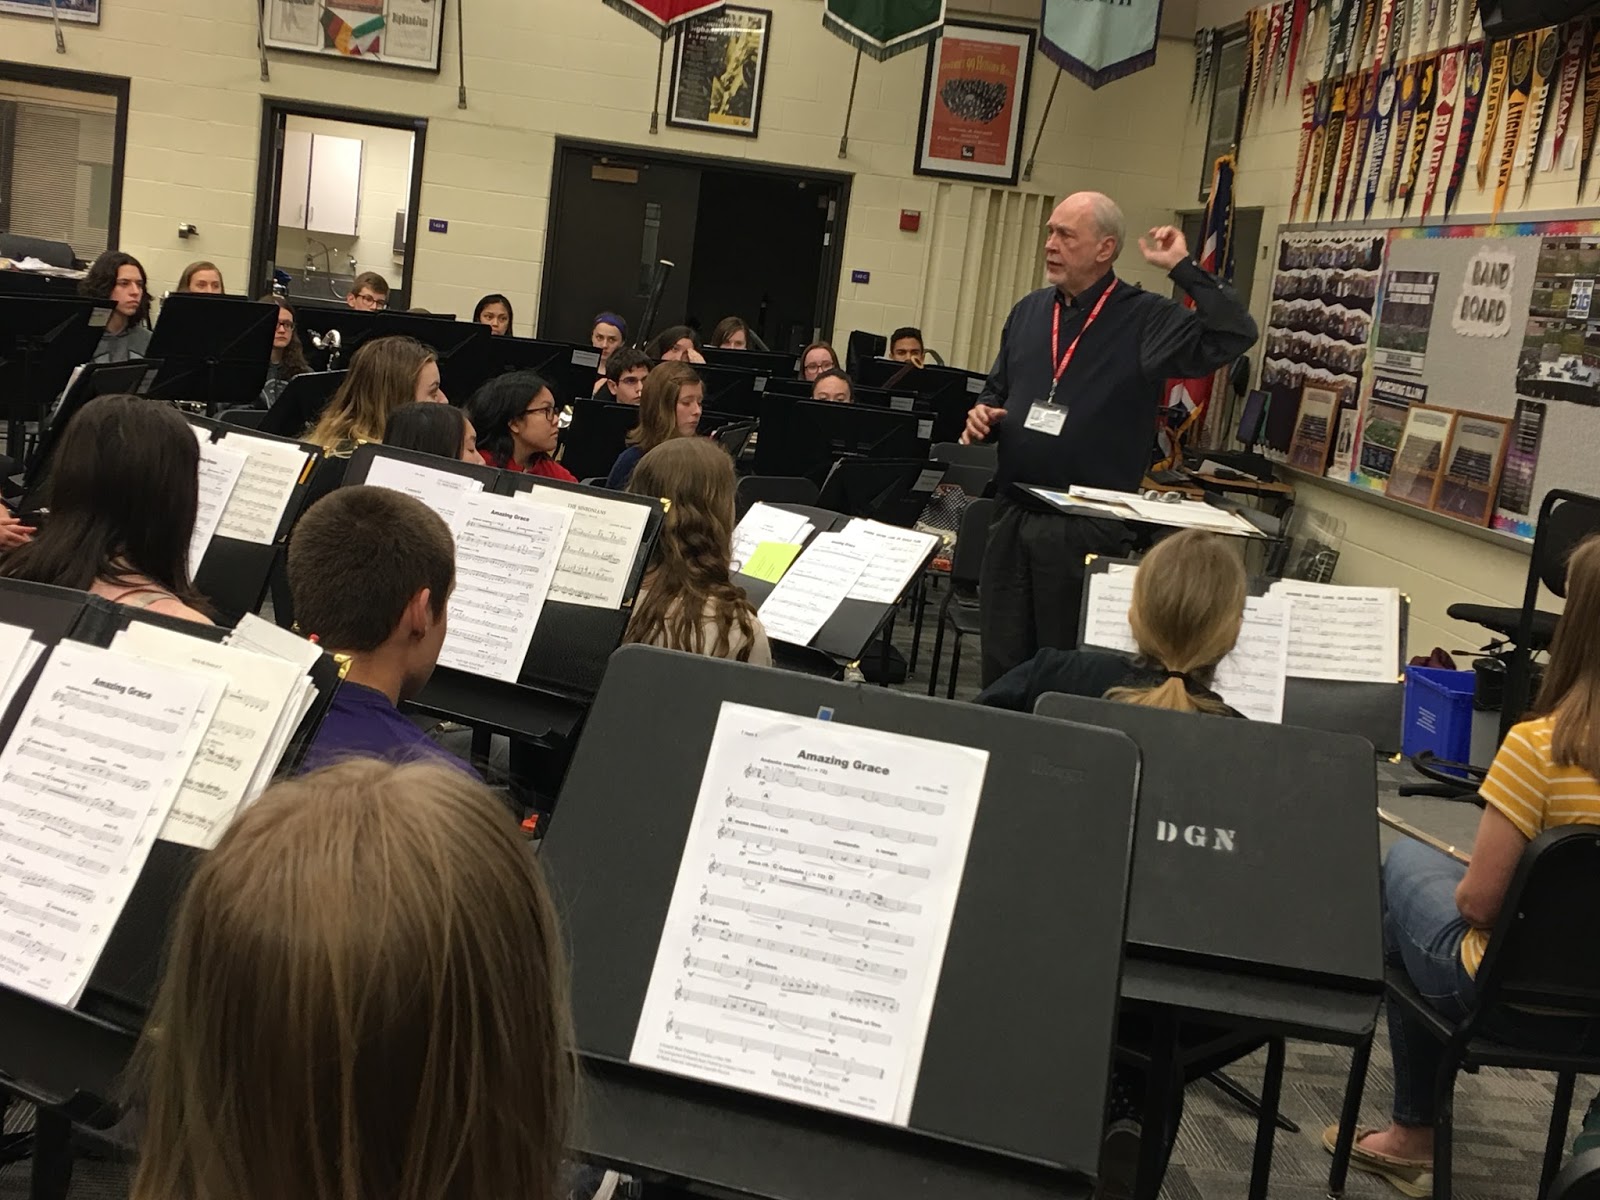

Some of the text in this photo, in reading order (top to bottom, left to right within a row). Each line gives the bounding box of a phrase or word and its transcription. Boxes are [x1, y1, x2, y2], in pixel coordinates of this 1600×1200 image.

[1555, 59, 1580, 138] INDIANA
[1408, 111, 1430, 186] IOWA
[1425, 114, 1450, 194] BRADLEY
[1450, 96, 1477, 187] KANSAS
[1497, 101, 1524, 188] AUGUSTANA
[1472, 260, 1511, 289] BAND
[1460, 295, 1507, 326] BOARD
[490, 509, 530, 522] Amazing Grace
[92, 677, 127, 694] Amazing
[127, 687, 153, 700] Grace
[797, 749, 890, 776] Amazing Grace
[1157, 820, 1236, 851] DGN
